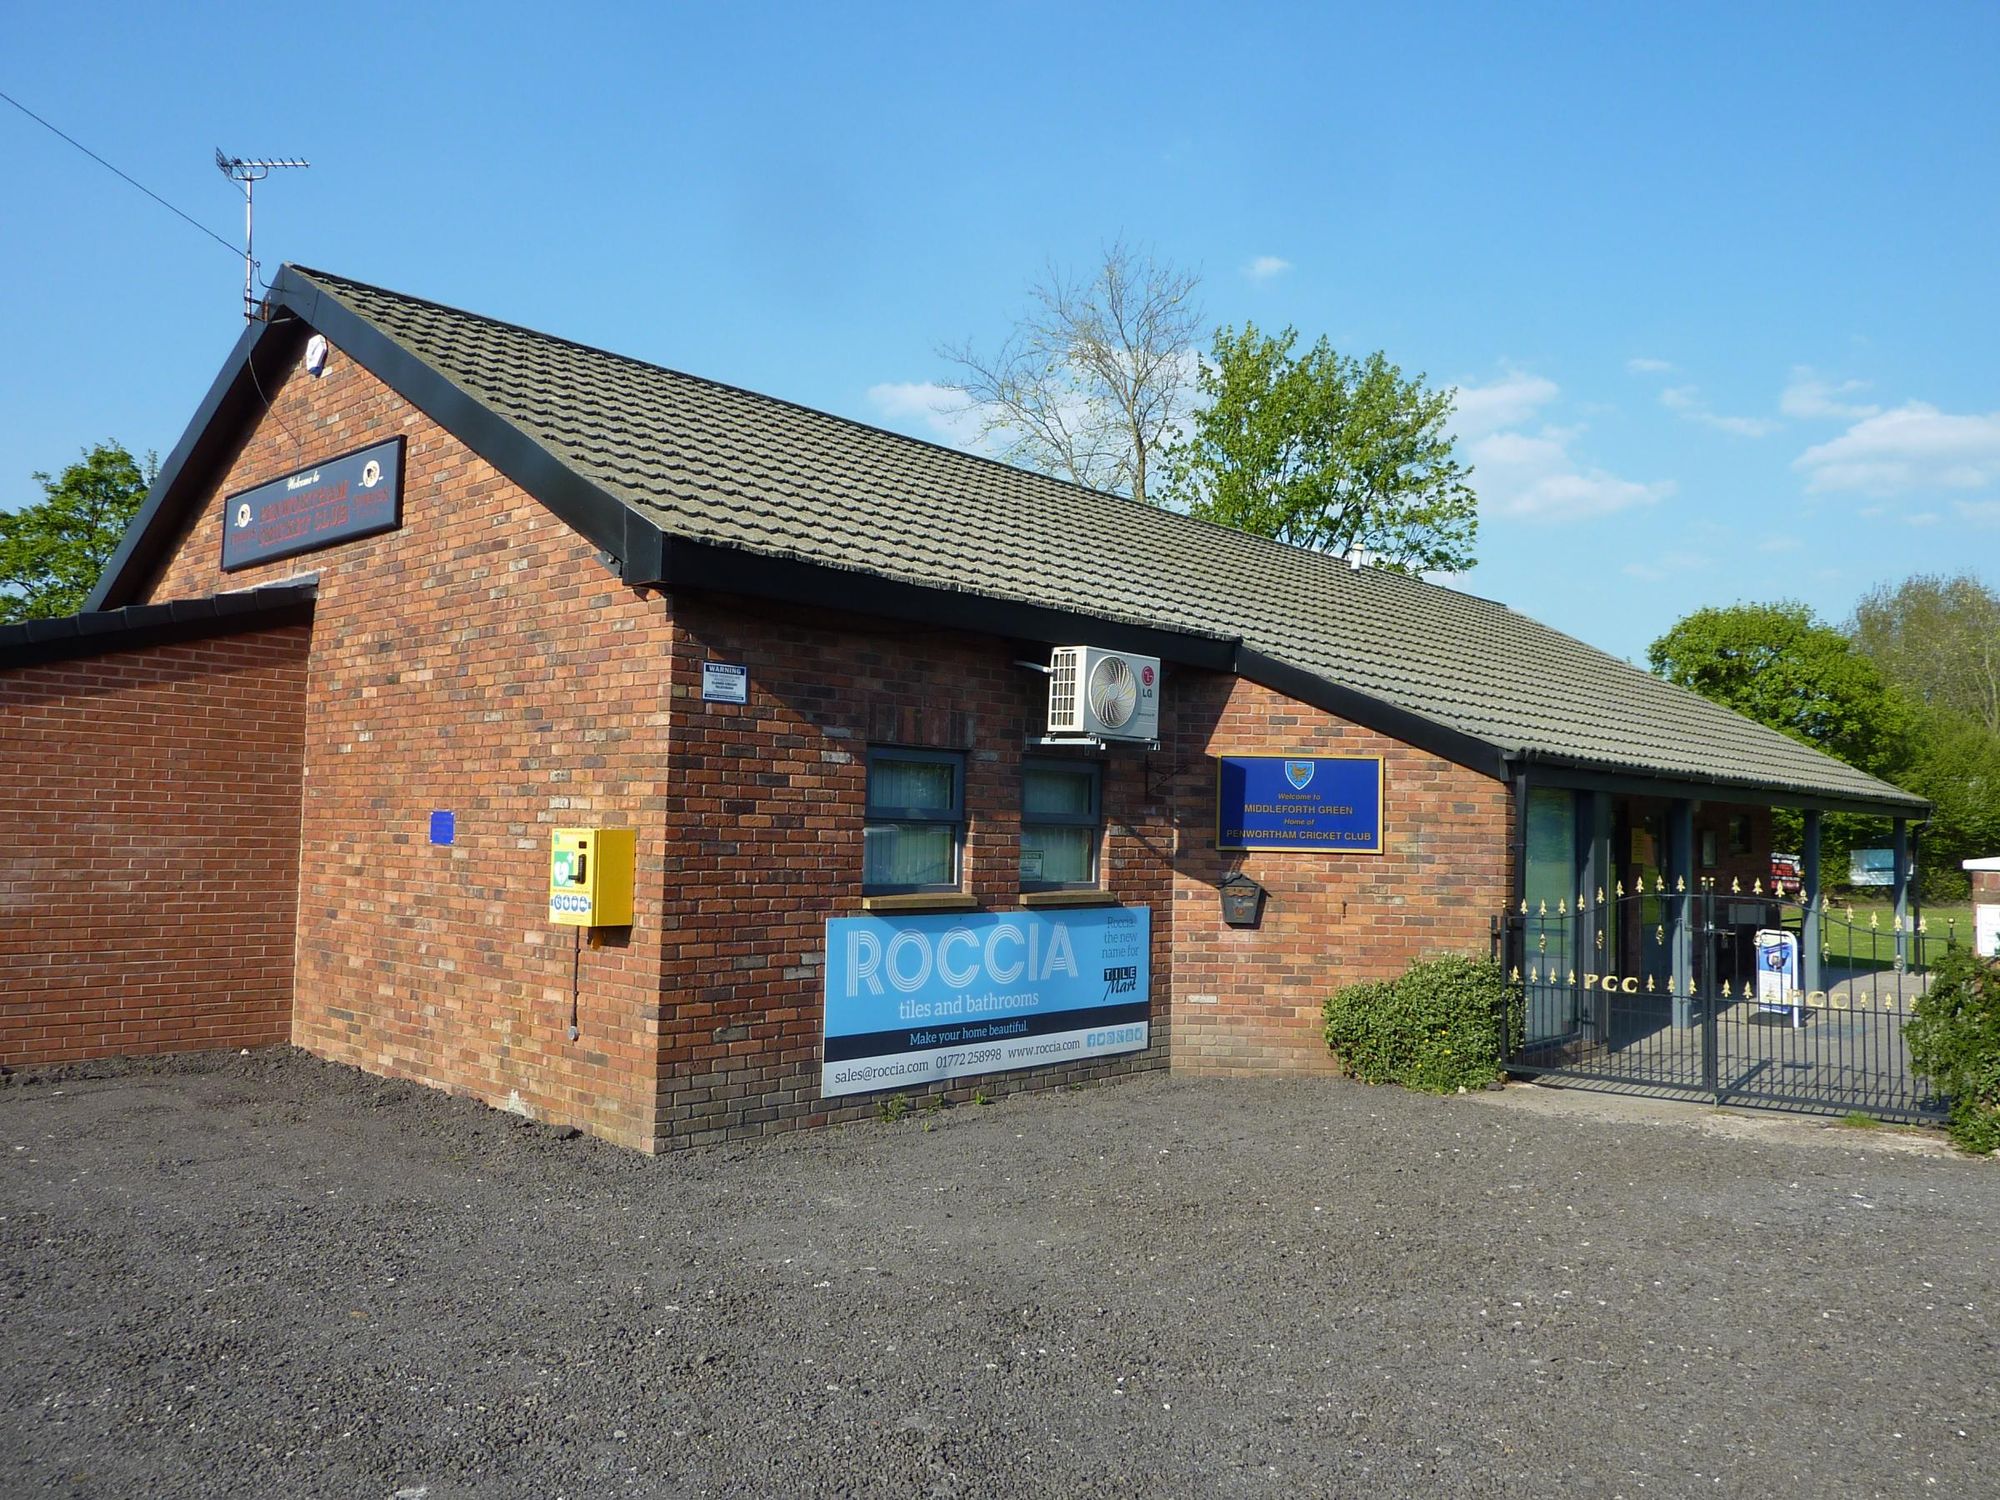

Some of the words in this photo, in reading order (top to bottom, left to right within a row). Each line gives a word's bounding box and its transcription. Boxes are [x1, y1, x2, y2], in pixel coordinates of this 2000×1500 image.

[708, 665, 742, 675] WARNING
[1142, 689, 1153, 698] LG
[1279, 792, 1312, 801] Welcome
[1313, 793, 1321, 801] to
[1244, 804, 1316, 814] MIDDLEFORTH
[1318, 805, 1353, 815] GREEN
[1284, 818, 1305, 826] Home
[1306, 818, 1315, 826] of
[1226, 829, 1297, 839] PENWORTHAM
[1299, 831, 1342, 840] CRICKET
[1344, 832, 1372, 841] CLUB
[1104, 931, 1118, 944] the
[1120, 932, 1138, 943] new
[1102, 947, 1126, 959] name
[1127, 944, 1140, 957] for
[846, 921, 1079, 997] ROCCIA
[1104, 967, 1136, 981] TILE
[1103, 979, 1136, 1001] Mart
[1583, 973, 1639, 993] PCC
[899, 999, 932, 1019] tiles
[934, 995, 962, 1016] and
[966, 992, 1040, 1013] bathrooms
[1787, 988, 1850, 1009] PCC
[910, 1031, 937, 1046] Make
[939, 1029, 960, 1044] your
[963, 1026, 987, 1039] home
[834, 1061, 929, 1083] sales@roccia.com
[936, 1052, 966, 1069] 01772
[967, 1048, 1002, 1065] 258998
[1008, 1038, 1081, 1059] www.roccia.com
